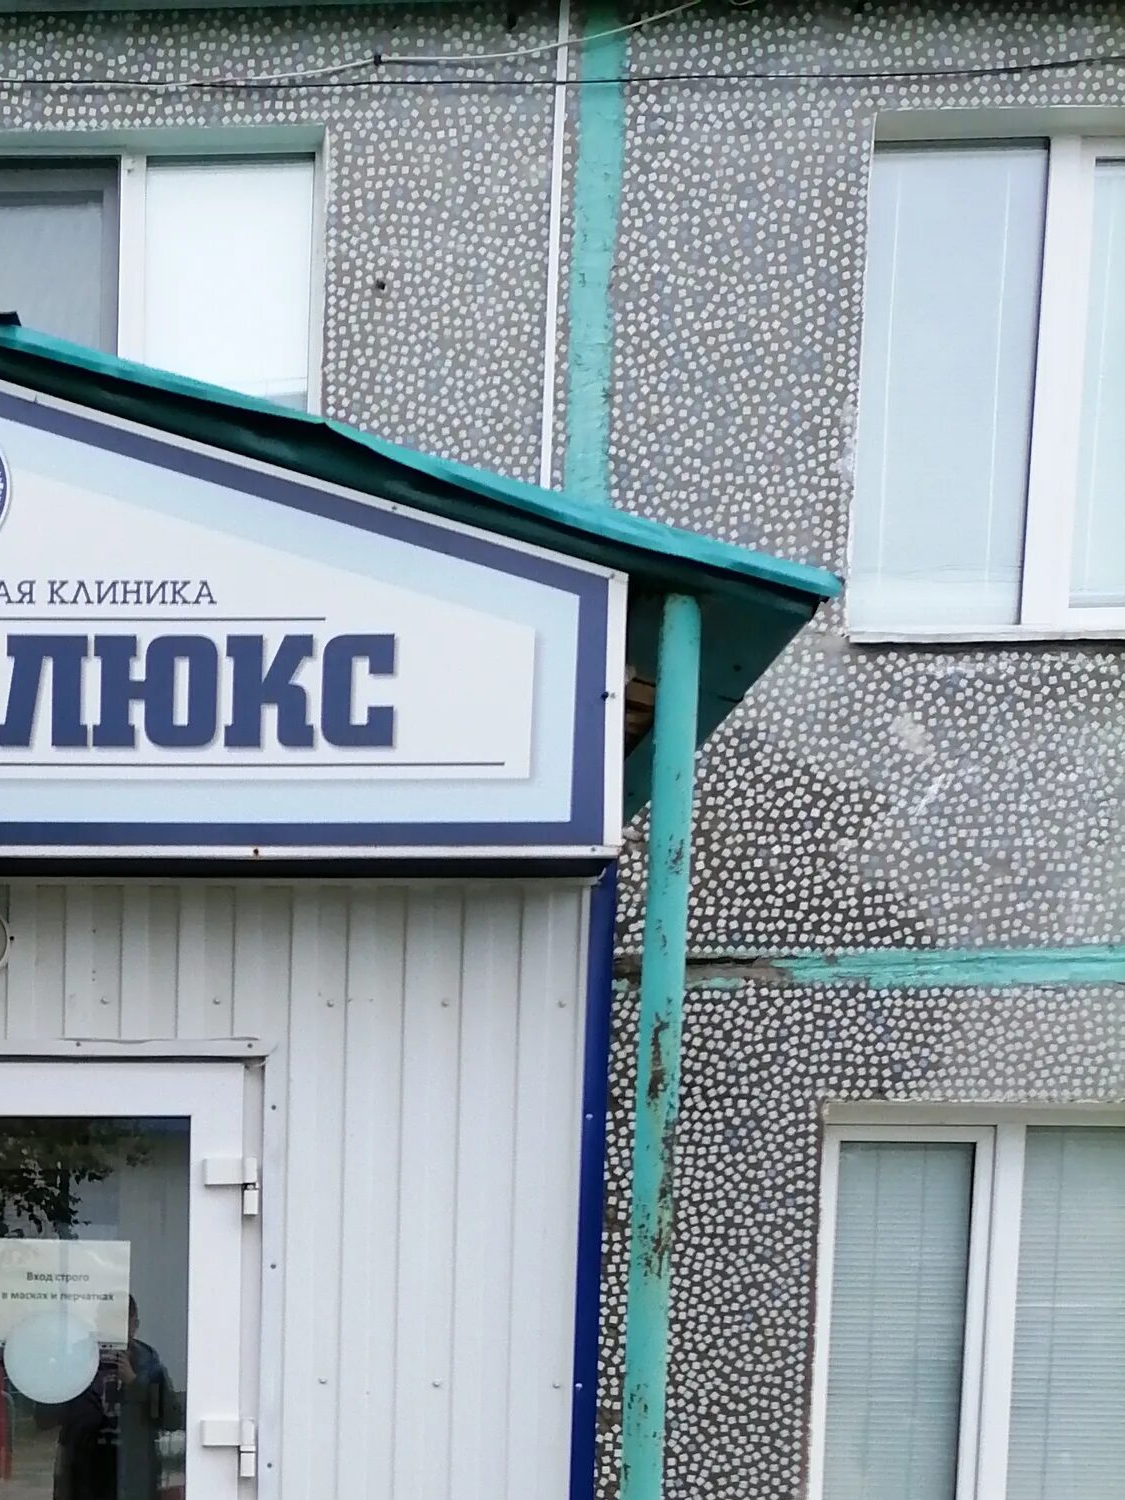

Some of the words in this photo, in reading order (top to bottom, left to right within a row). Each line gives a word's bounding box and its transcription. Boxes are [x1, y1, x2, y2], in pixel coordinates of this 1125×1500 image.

[47, 580, 217, 605] КЛИНИКА
[26, 1271, 53, 1282] Вход
[54, 1273, 90, 1283] строго
[10, 1292, 48, 1300] масках
[60, 1292, 114, 1302] перчатках
